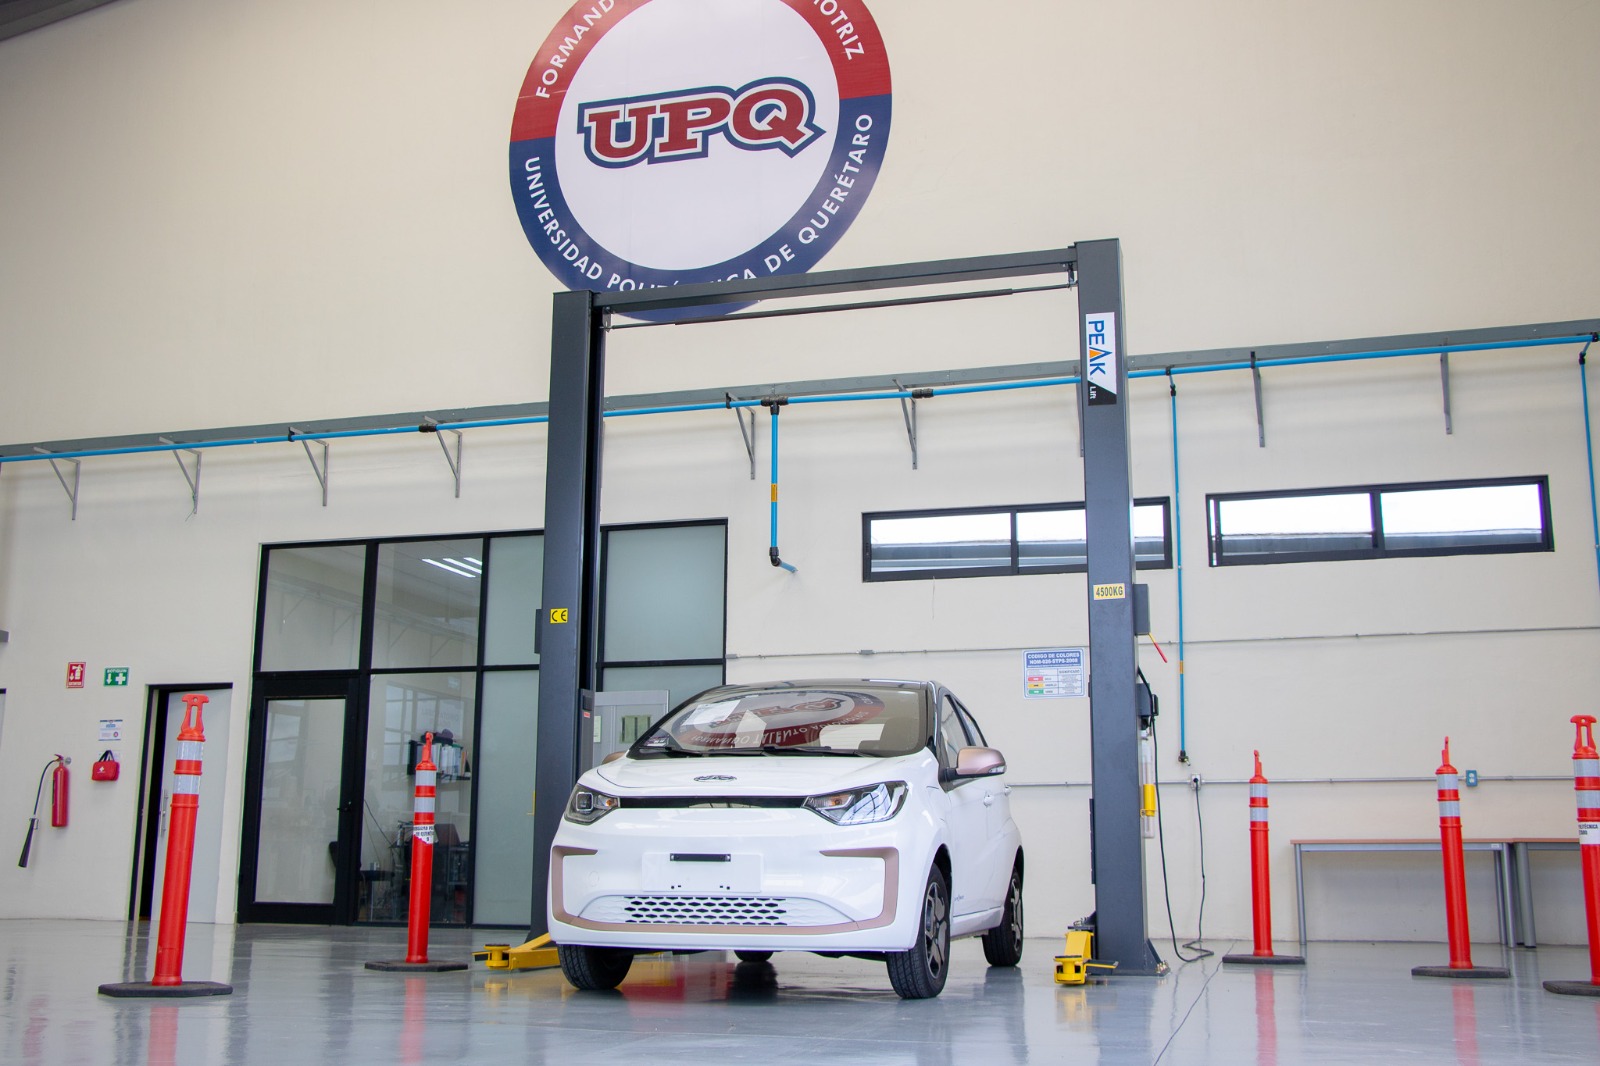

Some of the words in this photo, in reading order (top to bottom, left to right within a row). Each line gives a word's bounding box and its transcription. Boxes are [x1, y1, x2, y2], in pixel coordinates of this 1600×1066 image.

[577, 76, 826, 169] UPQ
[525, 156, 603, 280] UNIVERSIDAD
[763, 244, 796, 273] DE
[798, 114, 873, 244] QUERÉTARO
[1088, 320, 1113, 376] PEAK
[551, 609, 567, 622] CE
[1095, 586, 1124, 597] 4500KG
